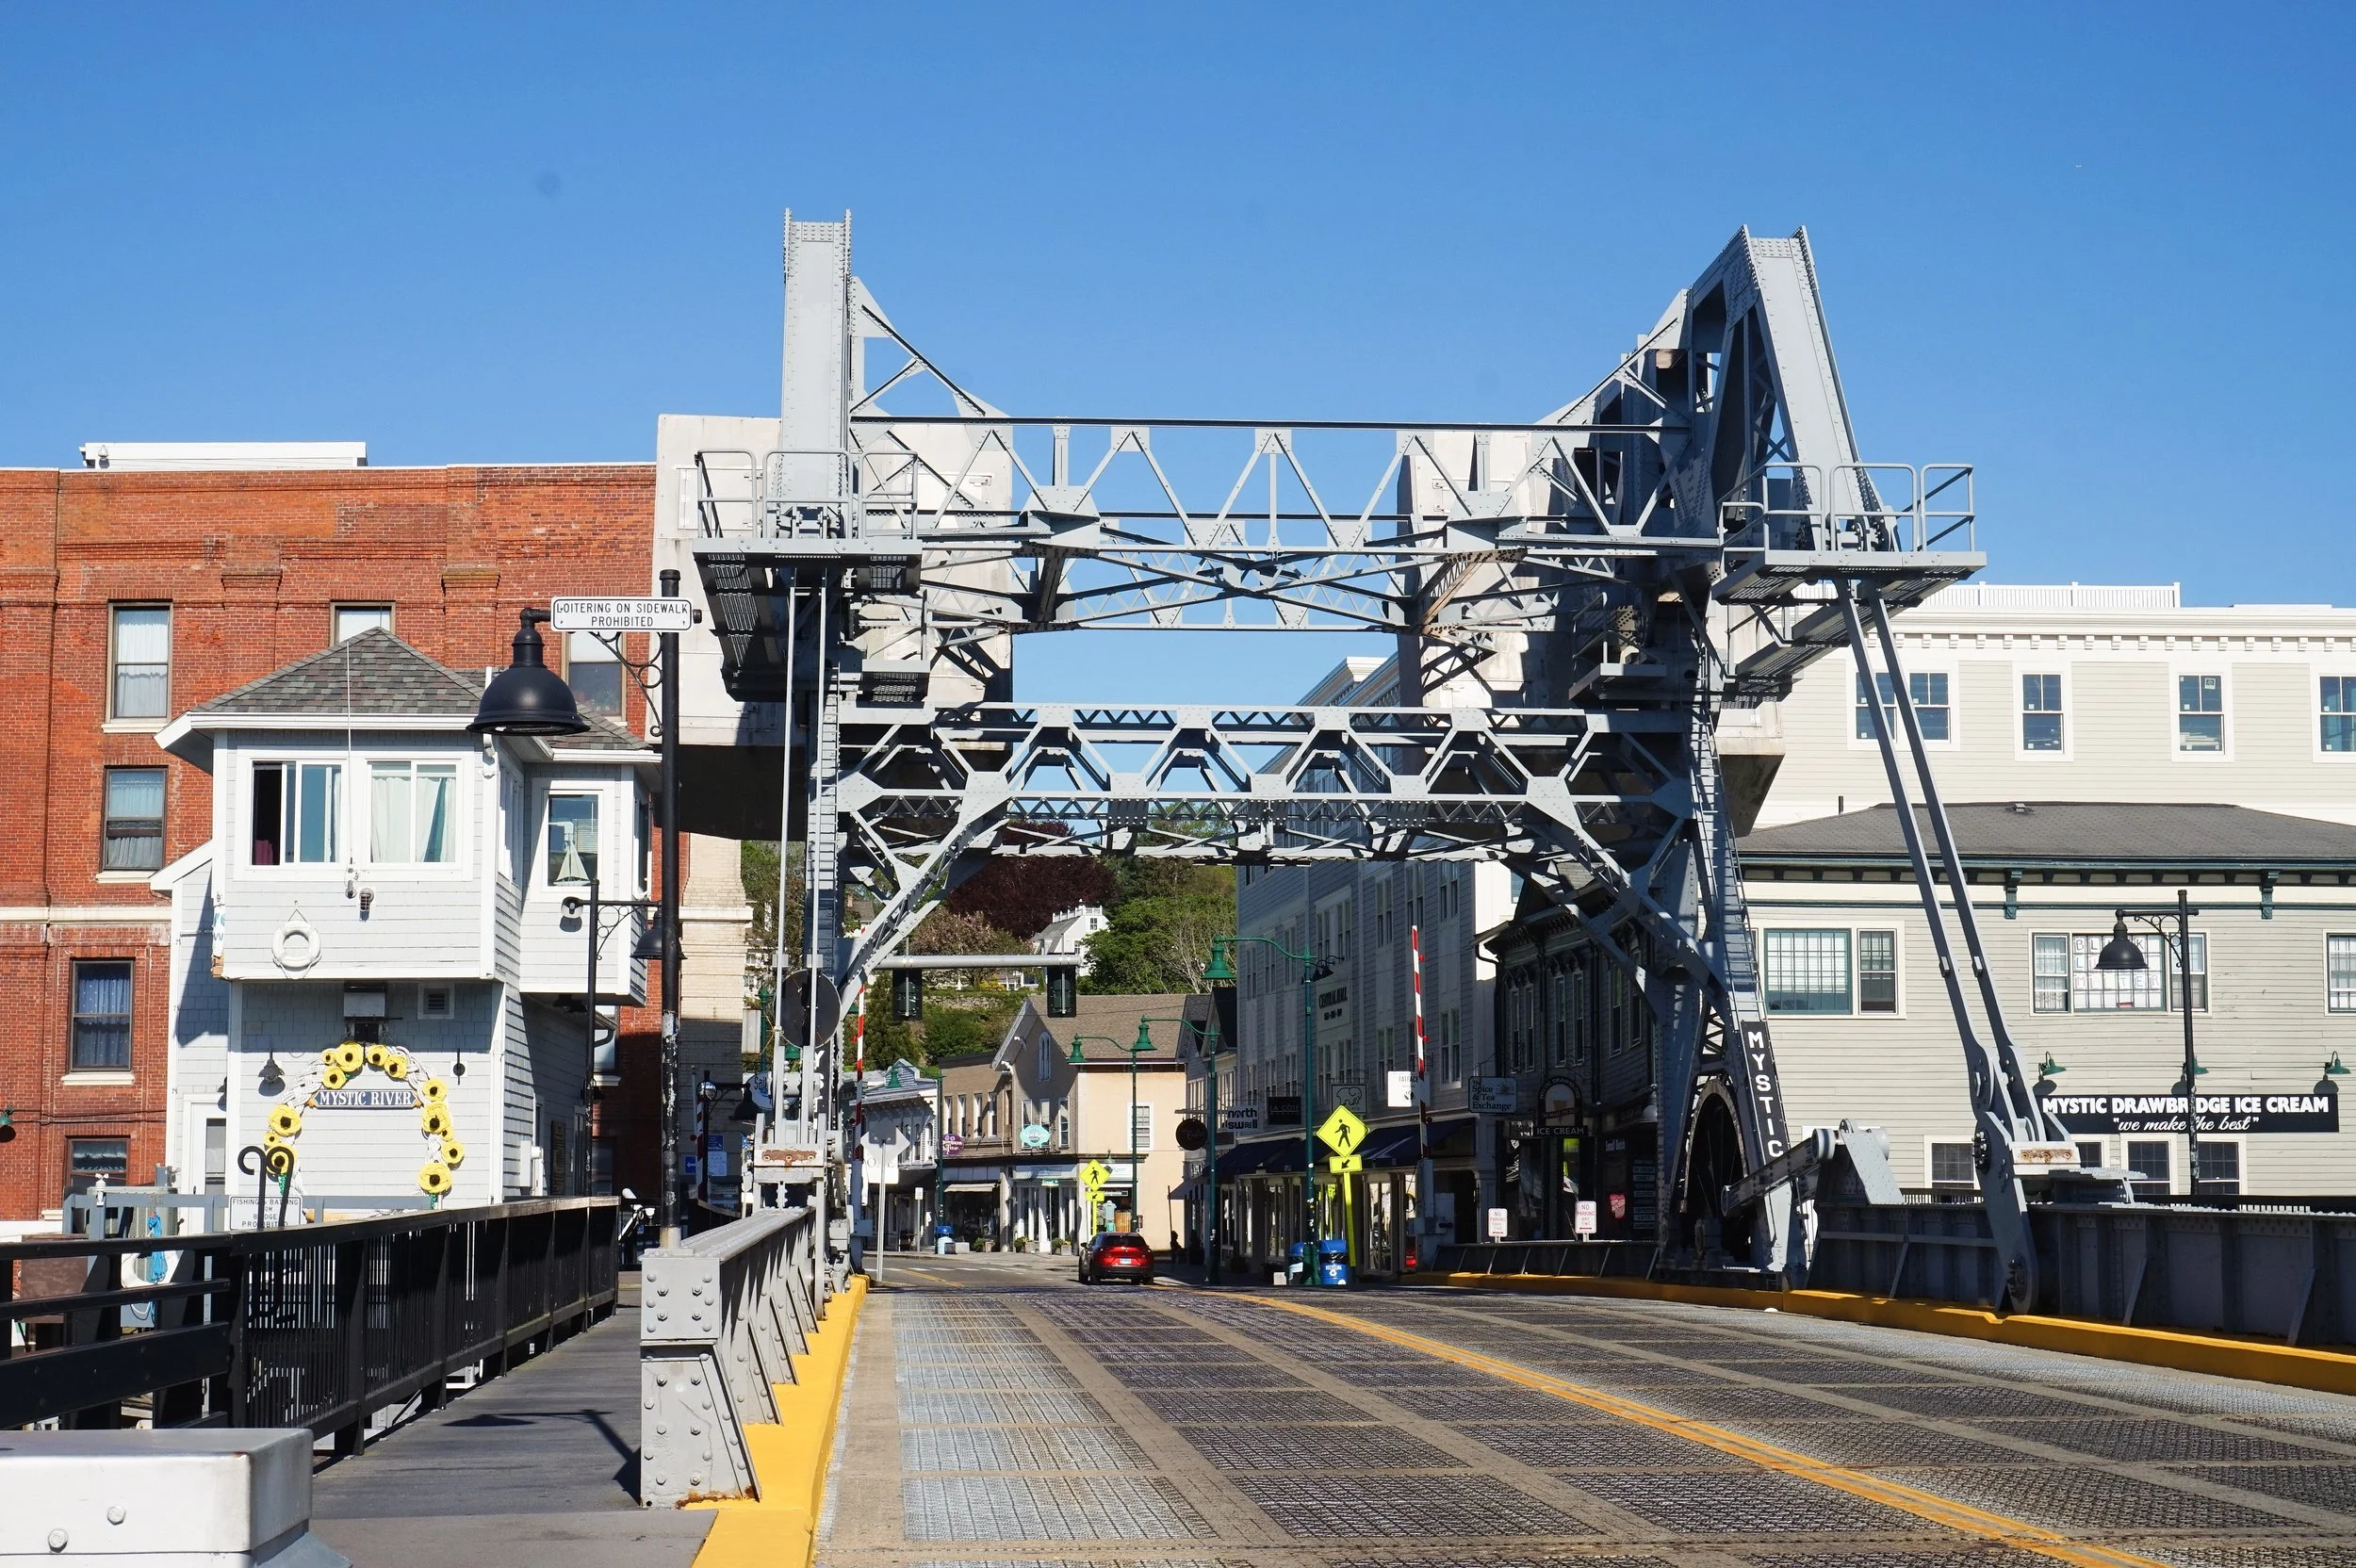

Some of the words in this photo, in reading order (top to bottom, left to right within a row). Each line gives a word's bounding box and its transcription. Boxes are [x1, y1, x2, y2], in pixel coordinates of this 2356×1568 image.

[556, 602, 612, 613] LOITERING
[616, 602, 630, 613] ON
[636, 602, 688, 614] SIDEWALK
[591, 615, 654, 627] PROHIBITED
[2075, 938, 2144, 950] BLK
[1472, 1085, 1494, 1094] Spice
[1747, 1031, 1784, 1158] MYSTIC
[319, 1090, 368, 1106] MYSTIC
[370, 1090, 412, 1106] RIVER
[1472, 1101, 1512, 1112] Exchange
[2042, 1097, 2107, 1114] MYSTIC
[2112, 1097, 2231, 1114] DRAWBRDGE
[2234, 1097, 2262, 1113] ICE
[2266, 1096, 2329, 1113] CREAM
[2143, 1115, 2187, 1131] make
[1536, 1127, 1550, 1135] ICE
[1553, 1127, 1584, 1135] CREAM
